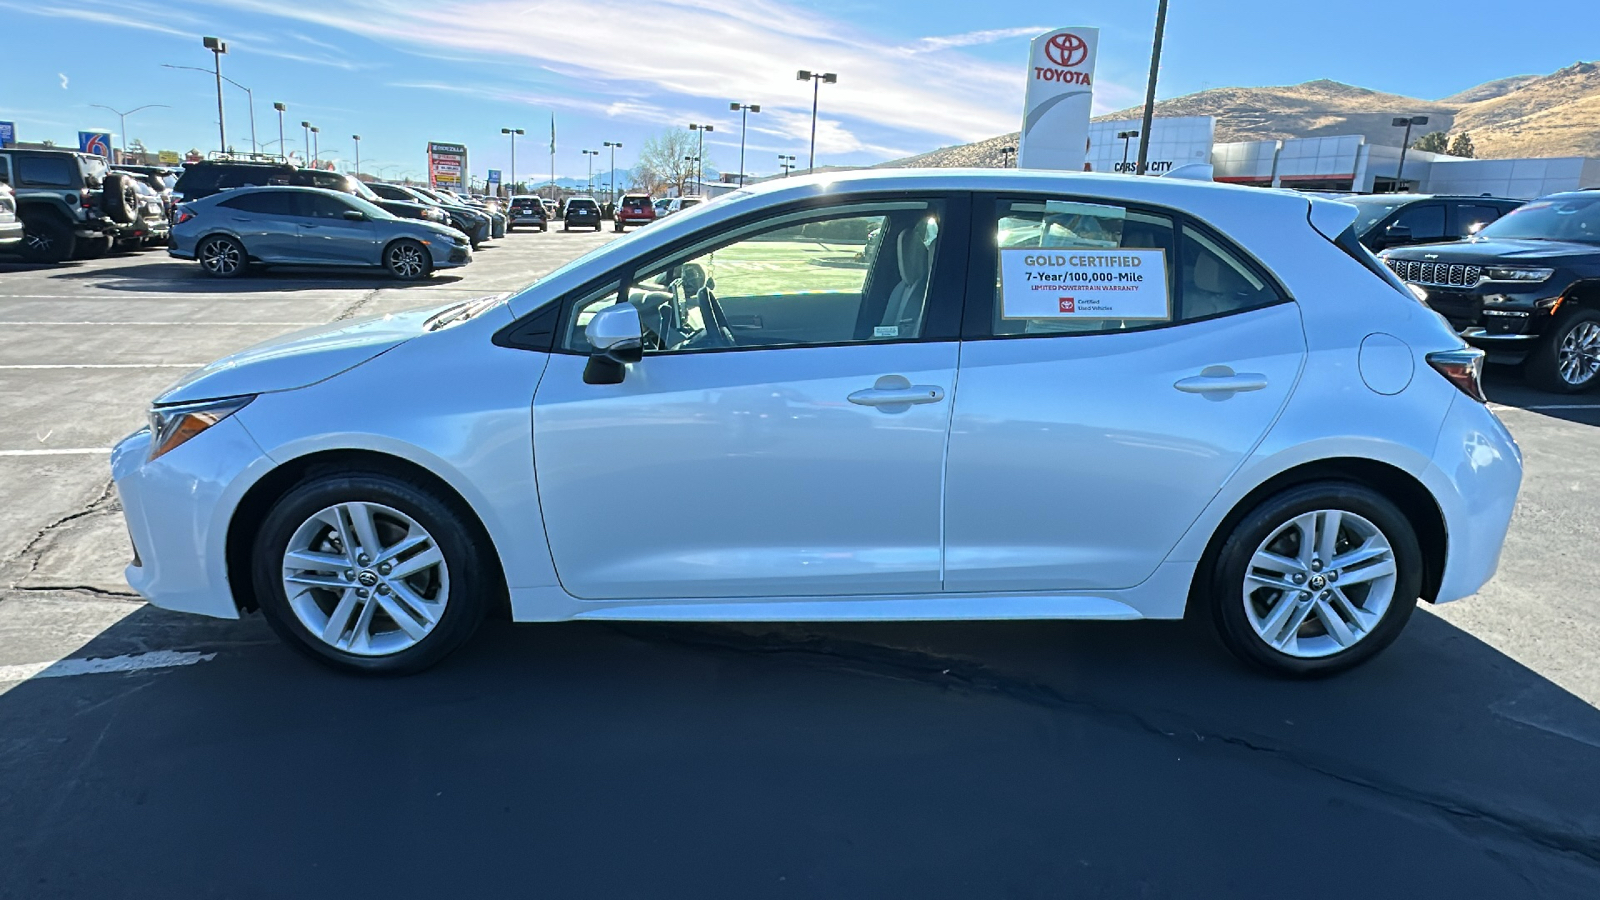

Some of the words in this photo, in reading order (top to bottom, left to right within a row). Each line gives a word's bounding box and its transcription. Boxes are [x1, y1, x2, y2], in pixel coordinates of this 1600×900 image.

[1035, 67, 1091, 85] TOYOTA
[1114, 162, 1150, 172] CARSN
[1151, 161, 1173, 172] CITY
[1024, 255, 1066, 267] GOLD
[1069, 256, 1142, 267] CERTIFIED
[1025, 272, 1143, 283] 7-Year/100,000-Mile
